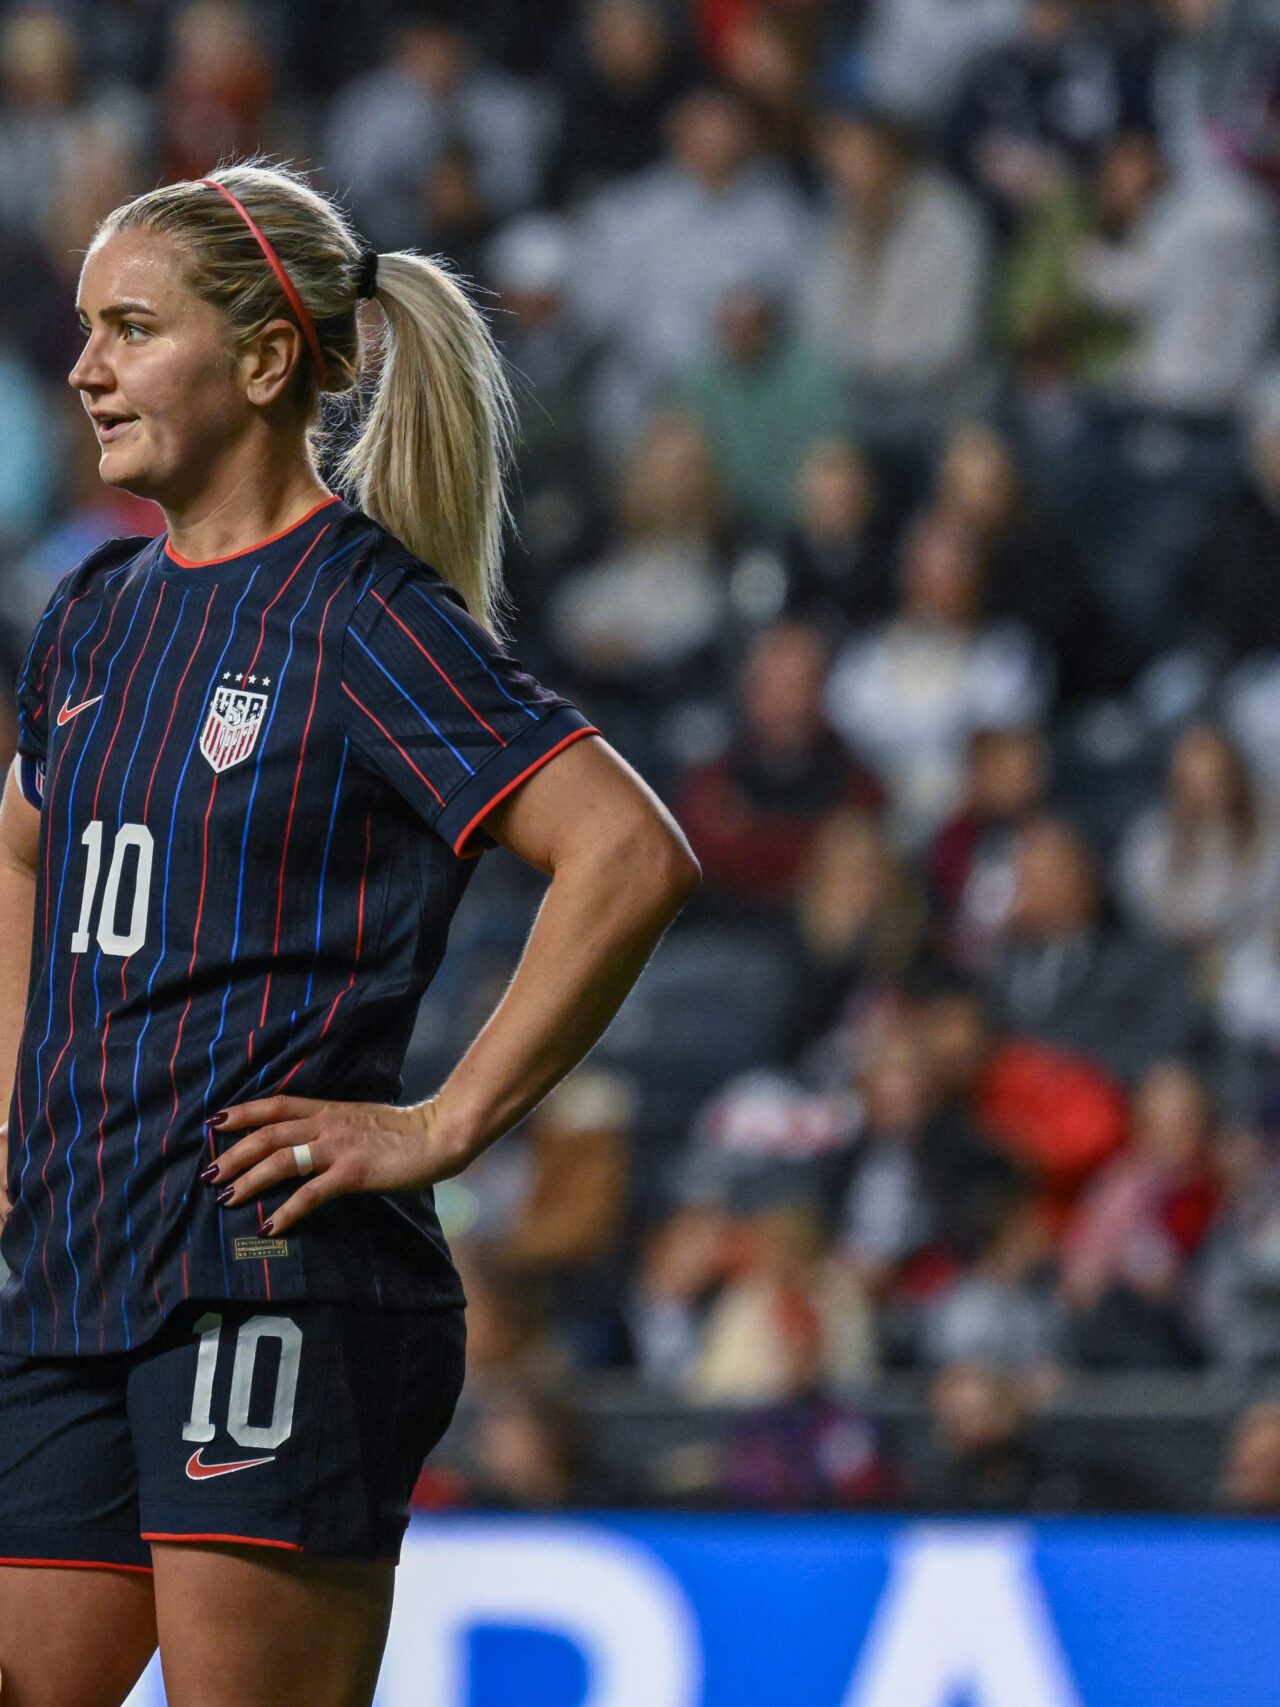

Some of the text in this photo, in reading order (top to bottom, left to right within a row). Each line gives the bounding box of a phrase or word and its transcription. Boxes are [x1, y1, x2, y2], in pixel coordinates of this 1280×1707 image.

[215, 691, 264, 727] USA
[71, 820, 154, 957] 10
[182, 1312, 303, 1449] 10
